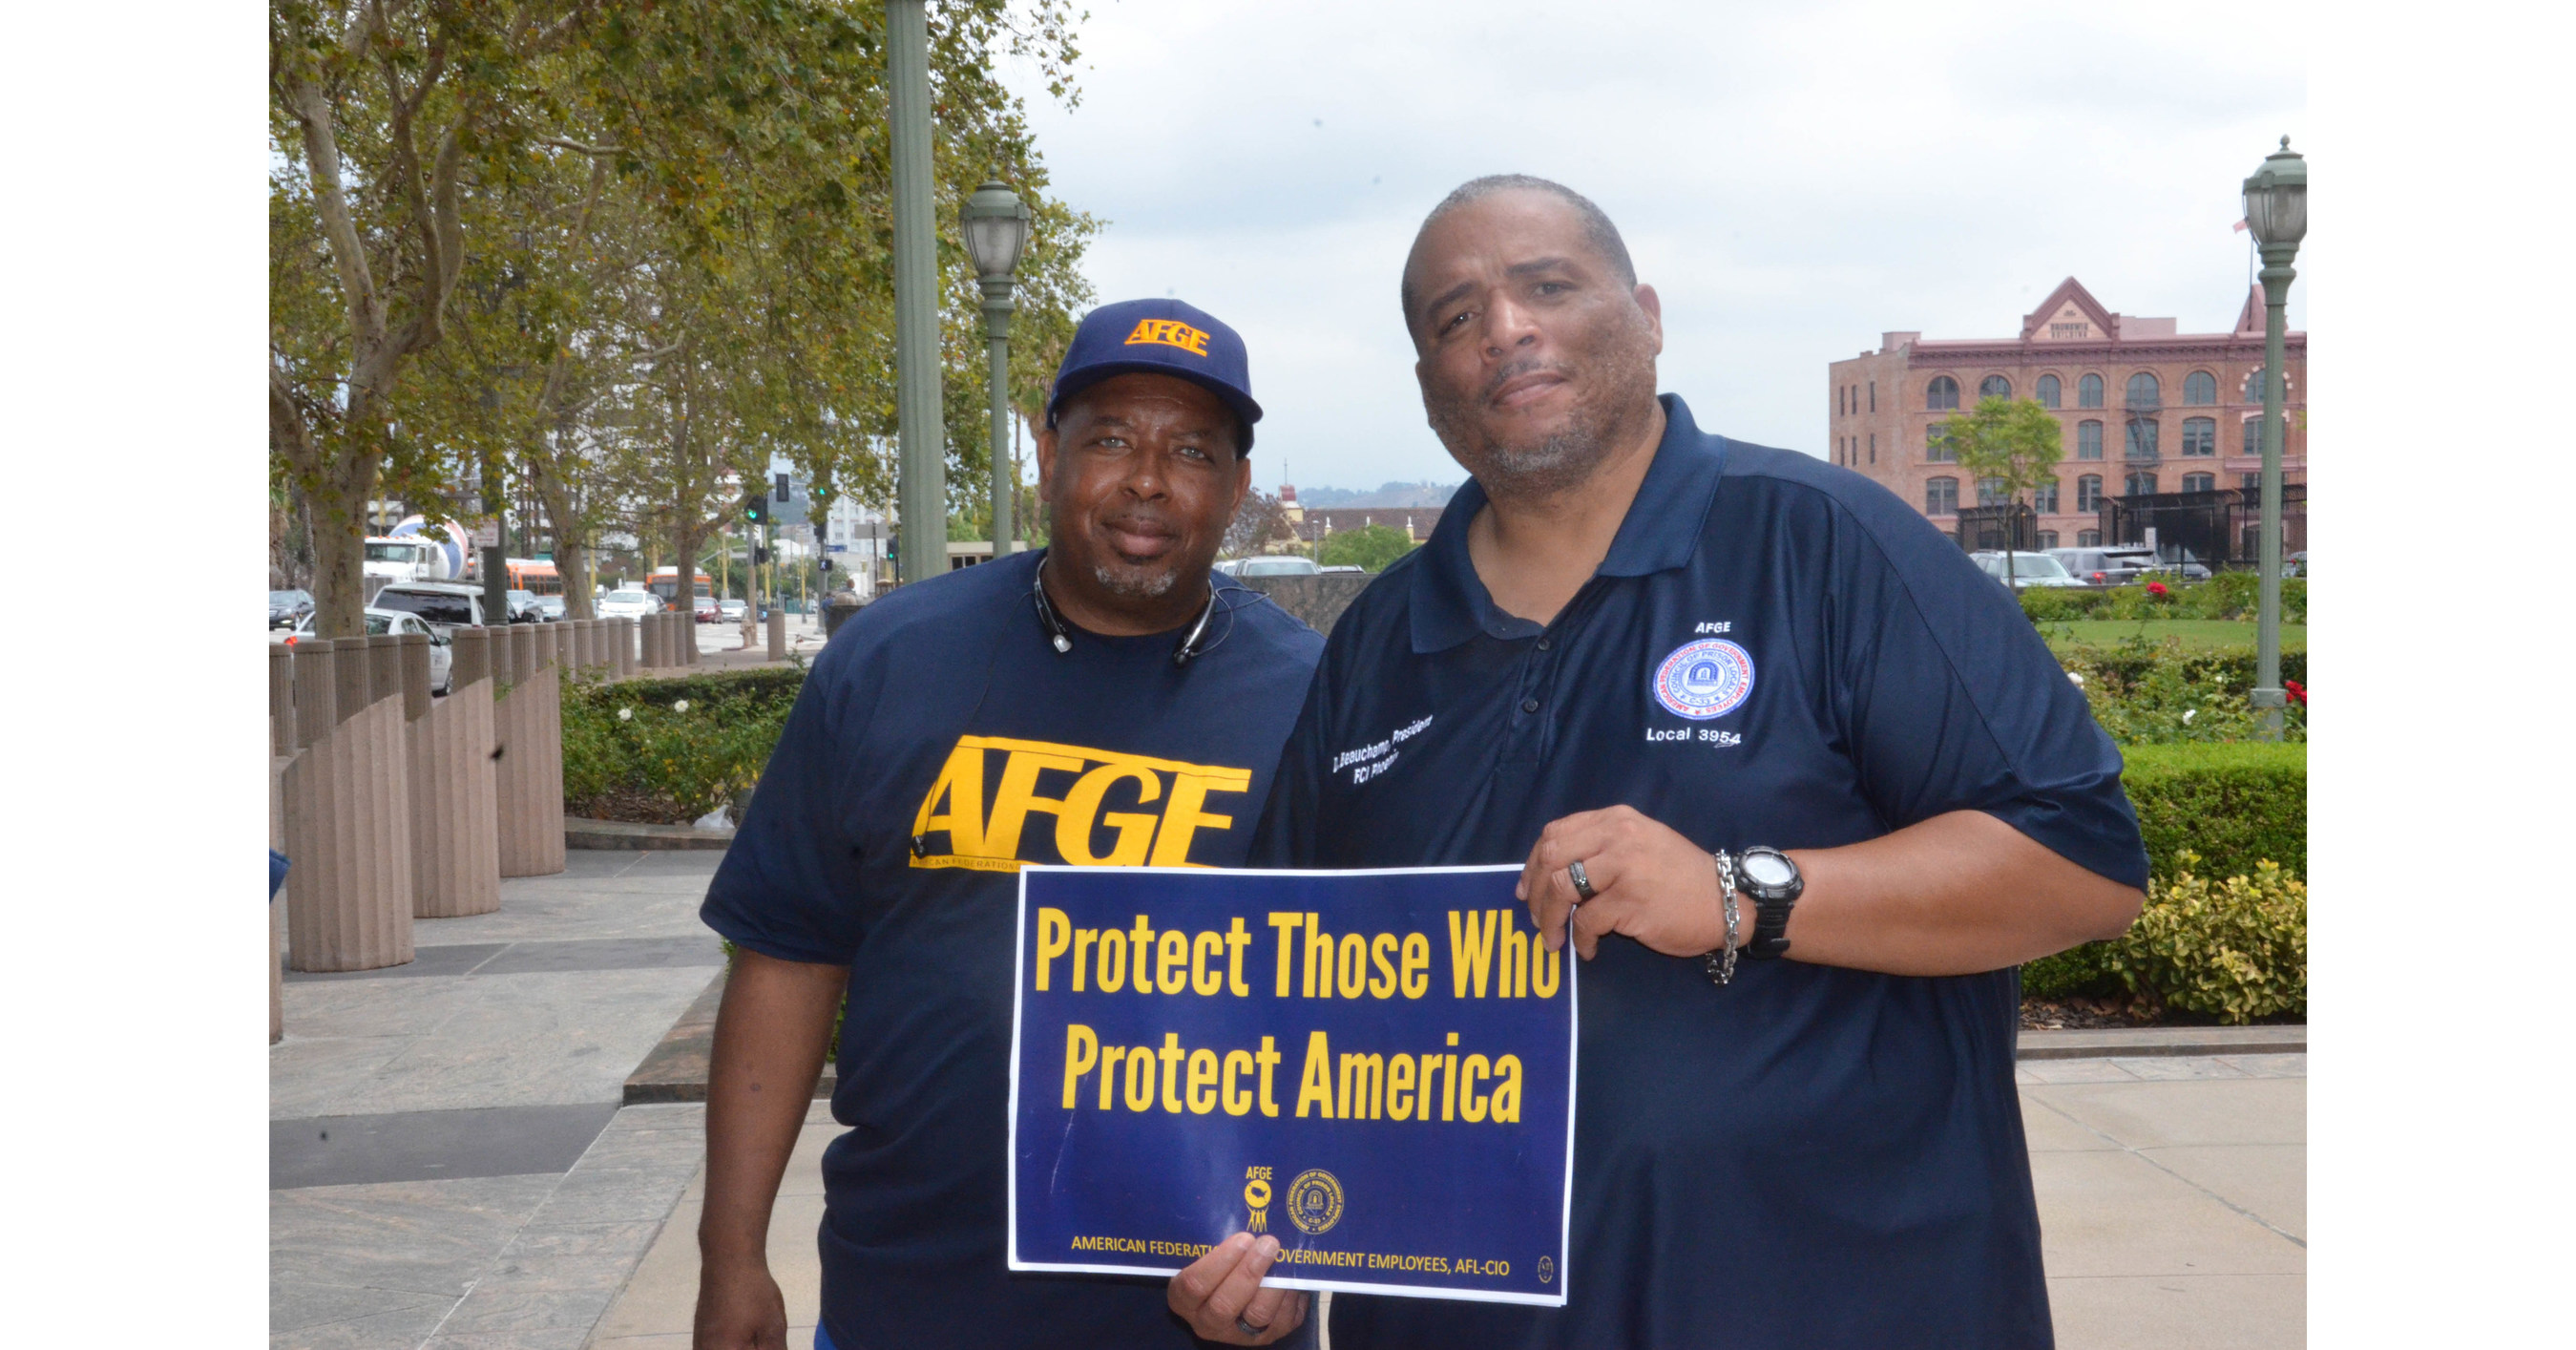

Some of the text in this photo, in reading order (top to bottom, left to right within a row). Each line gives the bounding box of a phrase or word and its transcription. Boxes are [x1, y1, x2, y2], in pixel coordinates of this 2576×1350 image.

[1124, 319, 1210, 358] AFGE
[1695, 622, 1731, 633] AFGE
[1702, 651, 1733, 665] PRISON
[1646, 727, 1741, 744] Local 3954
[1354, 749, 1399, 784] FCI Phoeni
[911, 735, 1251, 868] AFGE
[1035, 907, 1560, 1000] Protect Those Who
[1061, 1023, 1523, 1124] Protect America
[1246, 1166, 1272, 1180] AFGE
[1071, 1235, 1510, 1276] AMERICAN FEDERATI OVERNMENT EMPLOYEES, AFL-CIO
